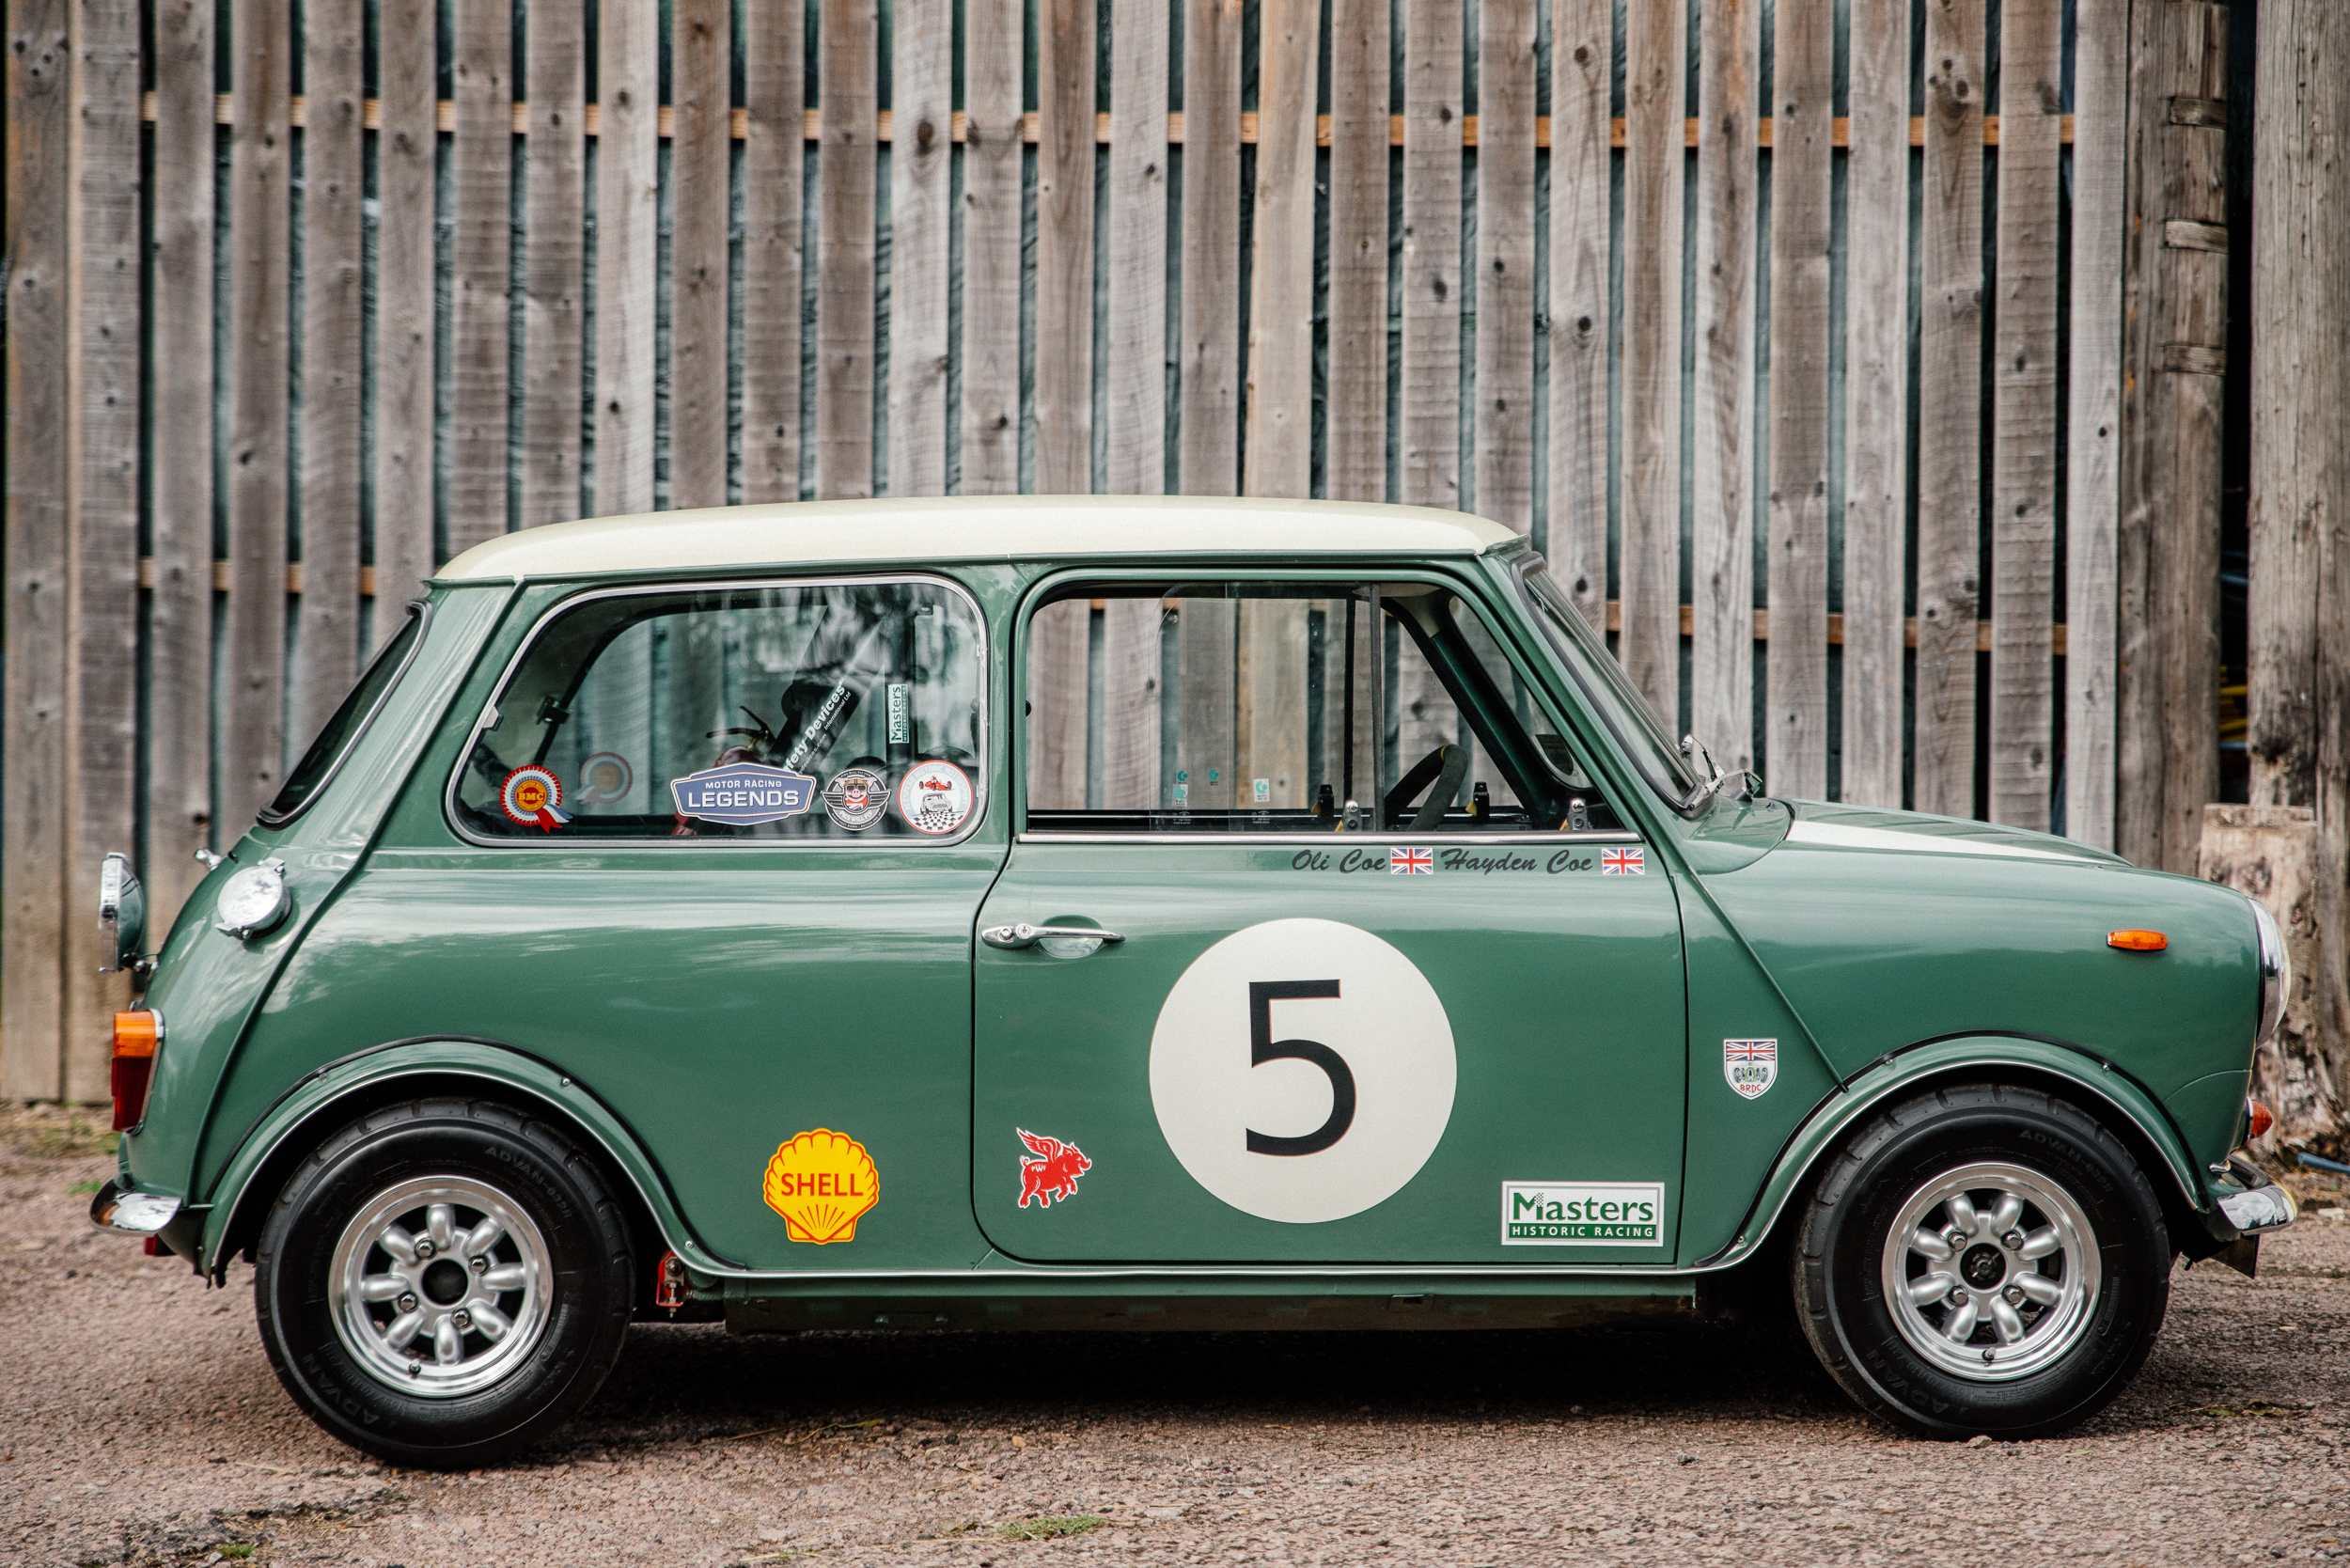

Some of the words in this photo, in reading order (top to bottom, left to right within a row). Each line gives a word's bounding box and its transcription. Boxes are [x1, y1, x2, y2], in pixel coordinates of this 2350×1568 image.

[805, 685, 846, 741] Devices
[823, 699, 846, 730] International
[843, 691, 852, 701] Ltd
[891, 686, 902, 741] Masters
[518, 792, 544, 801] BMC
[705, 780, 741, 789] MOTOR
[744, 779, 782, 788] RACING
[915, 765, 944, 778] HISTORIC
[945, 767, 969, 805] MOTORSPORT
[688, 790, 799, 808] LEGENDS
[838, 810, 851, 821] PIGS
[864, 809, 873, 819] FLY
[1292, 849, 1330, 871] Oli
[1339, 848, 1386, 874] Coe
[1440, 848, 1538, 875] Hayden
[1546, 849, 1593, 874] Coe
[1246, 979, 1357, 1157] 5
[1740, 1084, 1762, 1093] BRDC
[484, 1145, 572, 1219] ADVAN-032R
[1030, 1164, 1046, 1173] PWF
[780, 1172, 864, 1197] SHELL
[1512, 1192, 1654, 1222] Masters
[1512, 1226, 1586, 1237] HISTORIC
[1594, 1226, 1653, 1237] RACING
[301, 1353, 381, 1425] ADVAN
[1865, 1349, 1950, 1414] ADVAN
